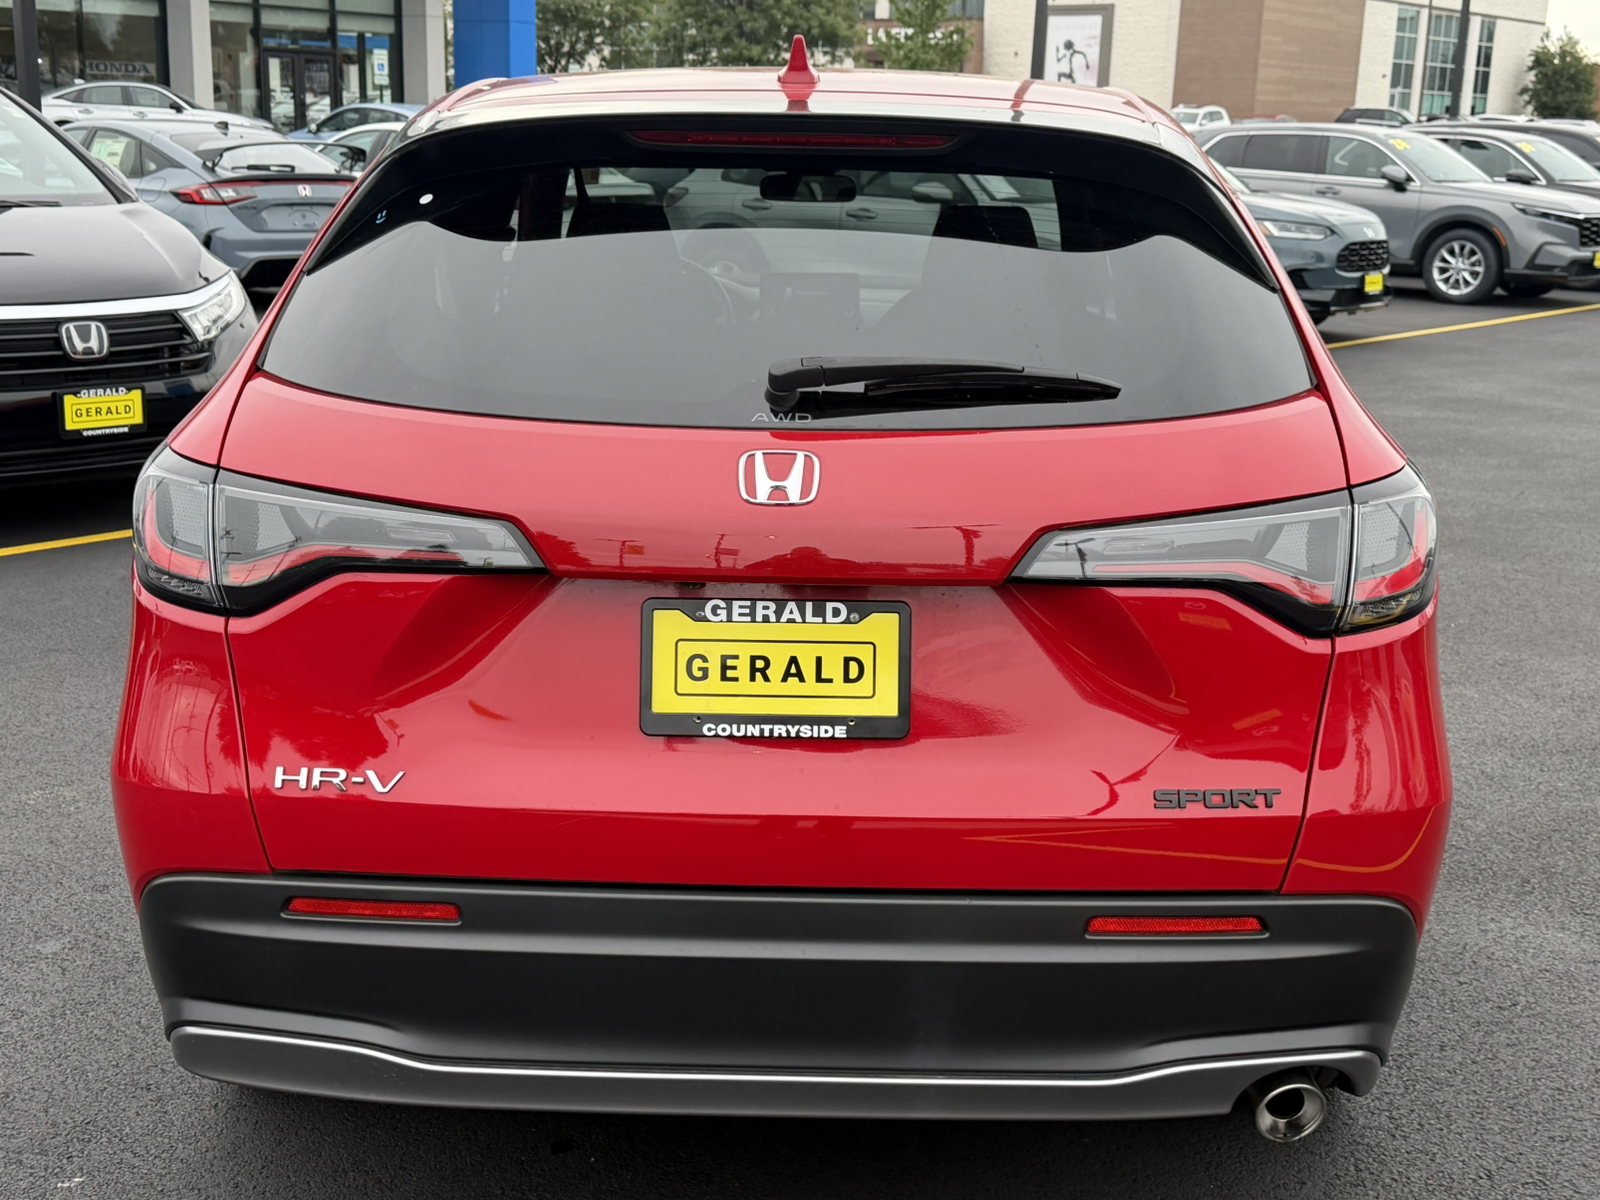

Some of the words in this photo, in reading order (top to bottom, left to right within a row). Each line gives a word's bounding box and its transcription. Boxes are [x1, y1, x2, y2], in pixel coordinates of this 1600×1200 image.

[80, 386, 128, 399] GERALD
[74, 404, 132, 418] GERALD
[750, 412, 812, 423] AWD
[82, 426, 129, 436] COUNTRYSIDE
[704, 599, 848, 624] GERALD
[685, 653, 866, 684] GERALD
[702, 723, 847, 738] COUNTRYSIDE
[274, 765, 406, 794] HR-V
[1153, 788, 1282, 809] SPORT
